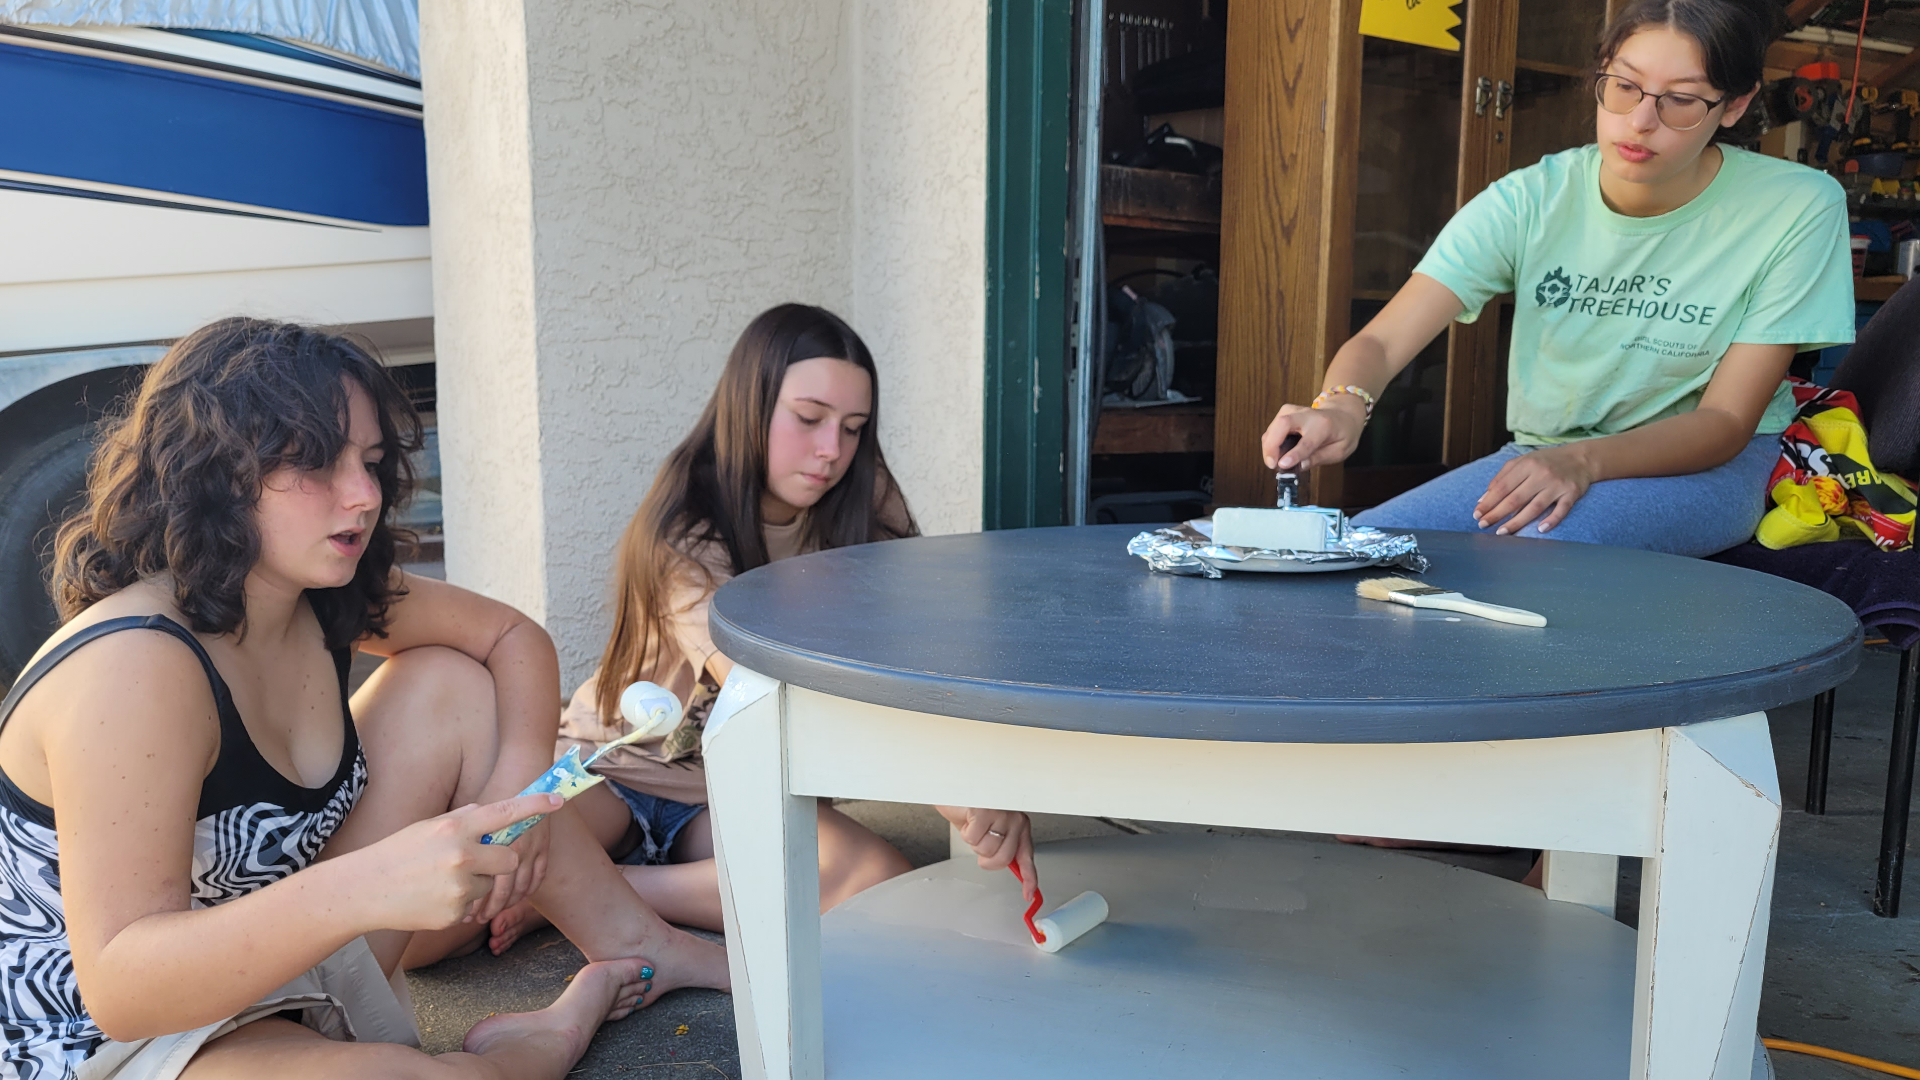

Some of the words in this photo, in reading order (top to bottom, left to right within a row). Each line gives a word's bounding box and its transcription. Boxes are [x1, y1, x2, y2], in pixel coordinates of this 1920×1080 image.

[1575, 274, 1671, 296] TAJAR'S
[1568, 297, 1716, 326] TREEHOUSE
[1620, 342, 1660, 354] NORTHERN
[1661, 348, 1710, 358] CALIFORNIA
[1653, 338, 1685, 350] SCOUTS
